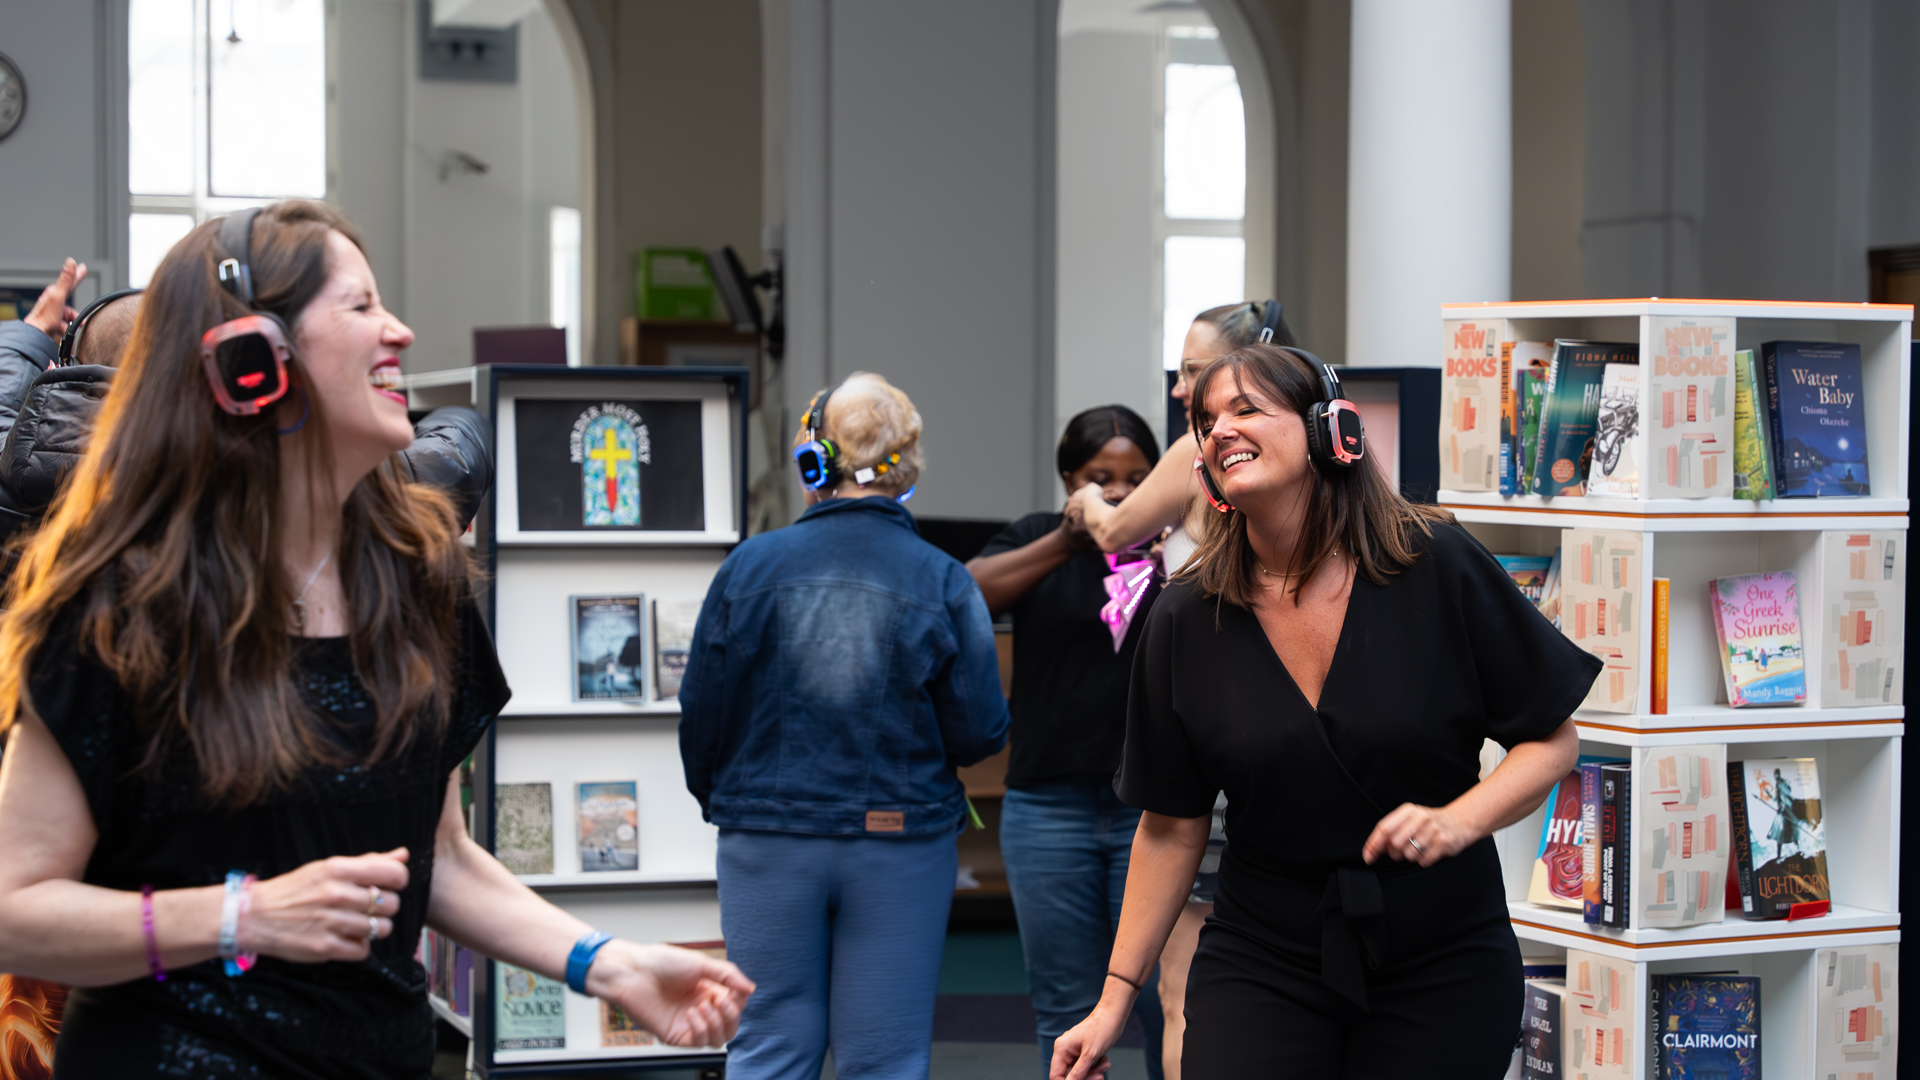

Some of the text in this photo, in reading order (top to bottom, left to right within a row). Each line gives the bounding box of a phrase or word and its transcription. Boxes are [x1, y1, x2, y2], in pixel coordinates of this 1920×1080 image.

[1454, 328, 1485, 350] NEW
[1664, 326, 1713, 347] NEW
[1447, 356, 1497, 378] BOOKS
[1575, 352, 1607, 362] FIONA
[1654, 354, 1728, 378] BOOKS
[1547, 360, 1559, 393] HAVEN
[1791, 368, 1838, 387] Water
[1819, 387, 1854, 409] Baby
[1800, 405, 1828, 415] Chioma
[1820, 417, 1850, 427] Okereke
[634, 424, 651, 465] HOLY
[1746, 584, 1775, 601] One
[1743, 599, 1784, 625] Greek
[1734, 618, 1797, 640] Sunrise
[1743, 686, 1772, 699] Mandy
[1582, 803, 1596, 882] SMALL HOURS
[1787, 863, 1801, 872] THE
[1758, 874, 1829, 899] LIGHTBORN
[1534, 996, 1548, 1011] THE
[1530, 1036, 1540, 1049] OF
[1651, 989, 1659, 1077] CLAIRMONT
[1662, 1033, 1758, 1049] CLAIRMONT
[1525, 1055, 1554, 1074] INDIAN
